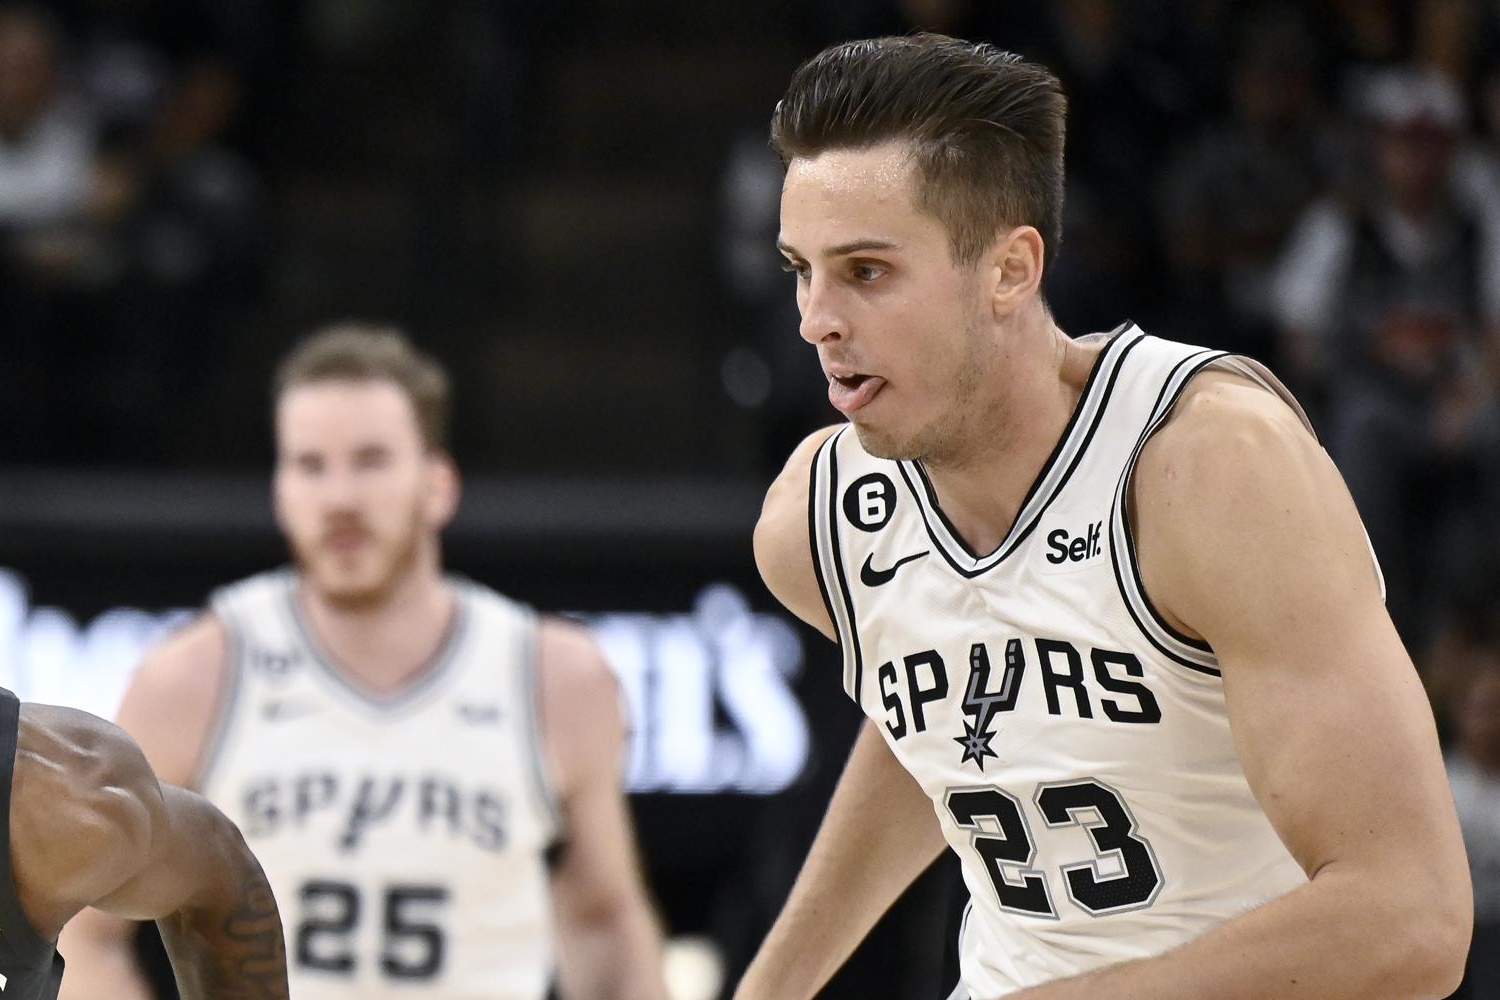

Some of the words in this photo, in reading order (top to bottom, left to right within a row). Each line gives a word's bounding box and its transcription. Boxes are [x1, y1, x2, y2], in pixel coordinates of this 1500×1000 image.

[858, 481, 887, 525] 6
[1045, 520, 1102, 564] Self.
[878, 637, 1162, 773] SPURS
[242, 770, 509, 858] SPURS
[942, 776, 1166, 921] 23
[296, 872, 454, 982] 25
